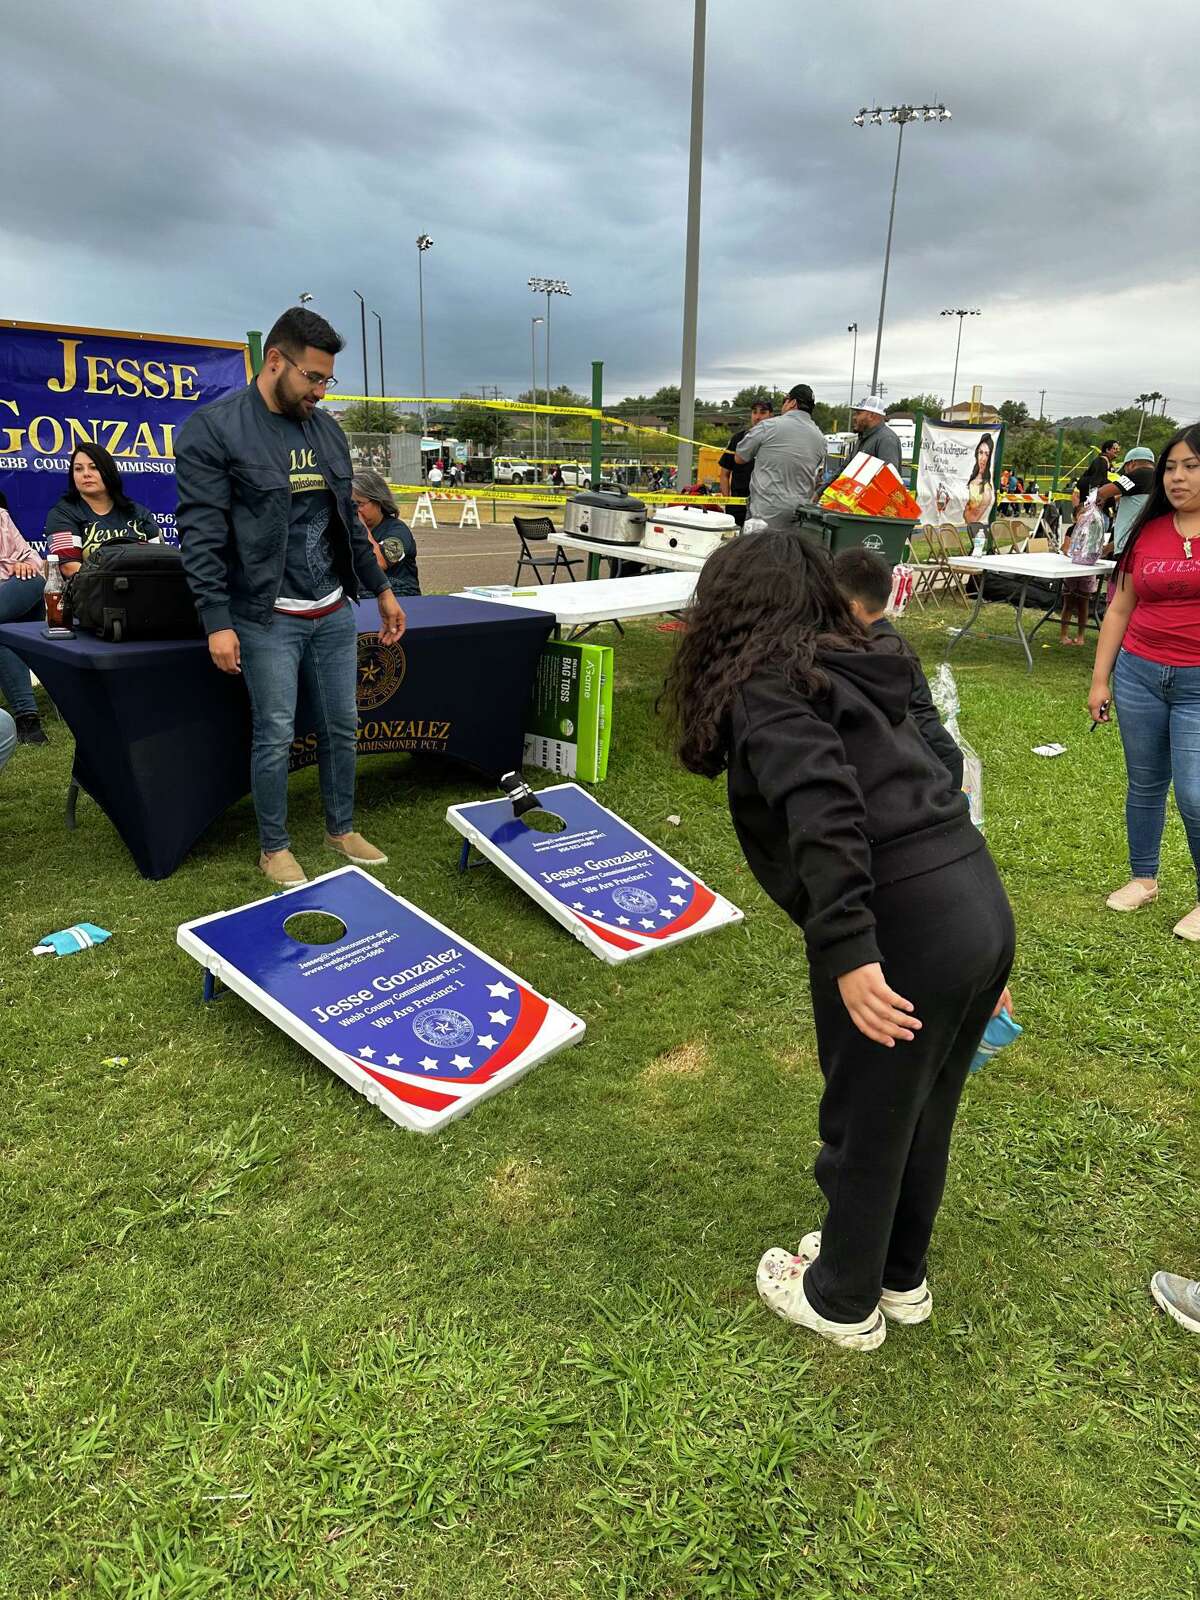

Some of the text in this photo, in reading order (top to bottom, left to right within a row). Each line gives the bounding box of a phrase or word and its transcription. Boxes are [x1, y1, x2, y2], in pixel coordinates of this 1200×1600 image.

[47, 338, 201, 401] JESSE
[0, 399, 176, 460] GONZAL
[0, 457, 176, 474] EBB COUN MMISSIO
[290, 448, 318, 471] sse
[82, 520, 129, 549] Jesse
[560, 657, 572, 703] BAG TOSS
[354, 717, 452, 741] GONZALEZ
[540, 849, 653, 884] Jesse Gonzalez
[582, 886, 600, 894] We
[599, 882, 615, 890] Are
[612, 873, 647, 886] Precinct
[311, 948, 463, 1024] Jesse Gonzalez
[338, 1011, 366, 1028] Webb
[364, 999, 394, 1016] County
[392, 972, 446, 1002] Commissioner
[444, 965, 461, 977] Pct.
[370, 979, 466, 1029] We Are Precinct 1
